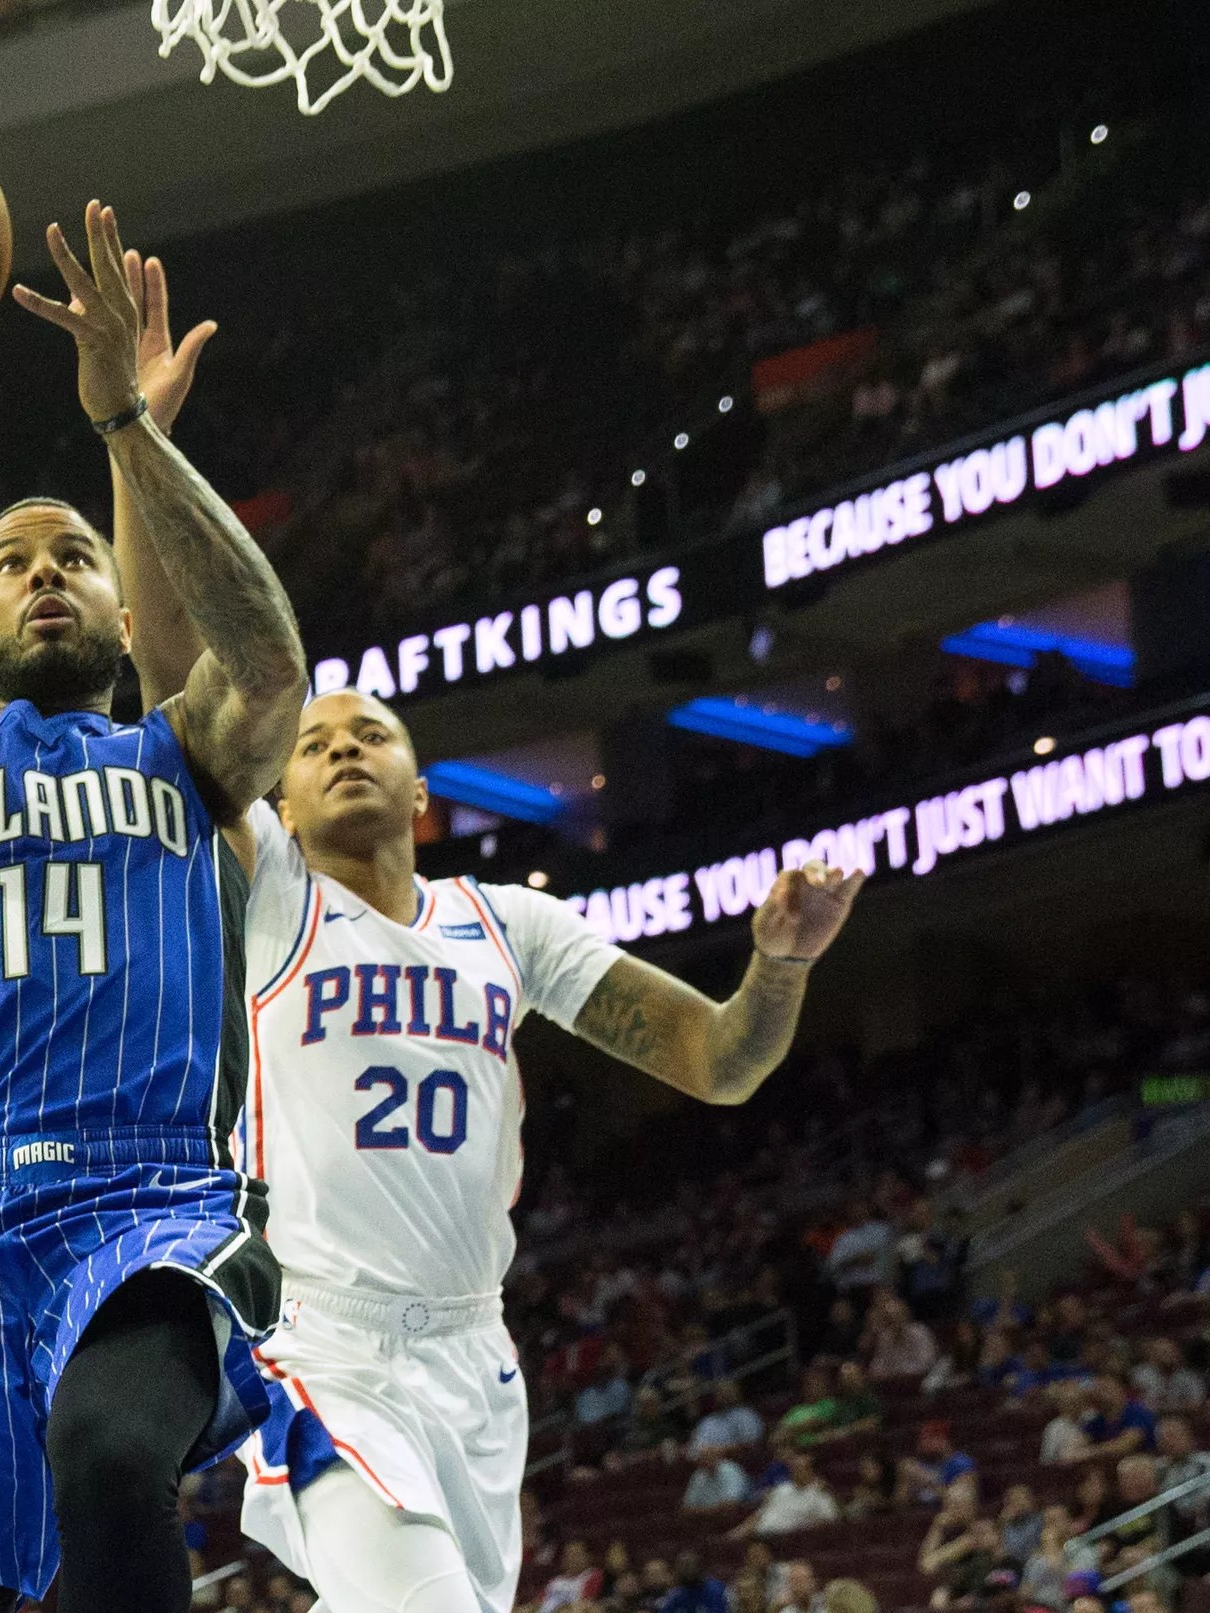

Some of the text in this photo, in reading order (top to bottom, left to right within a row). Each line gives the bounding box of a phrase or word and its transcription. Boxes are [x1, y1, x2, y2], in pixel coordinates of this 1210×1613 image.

[763, 472, 934, 588] BECAUSE
[934, 435, 1028, 522] YOU
[1032, 377, 1177, 489] DON'T
[304, 566, 683, 708] RAFTKINGS
[694, 848, 778, 922] YOU
[912, 776, 1008, 875] JUST
[1010, 733, 1150, 831] WANT
[1152, 715, 1210, 789] TO
[12, 1141, 76, 1169] MAGIC
[355, 1065, 468, 1155] 20
